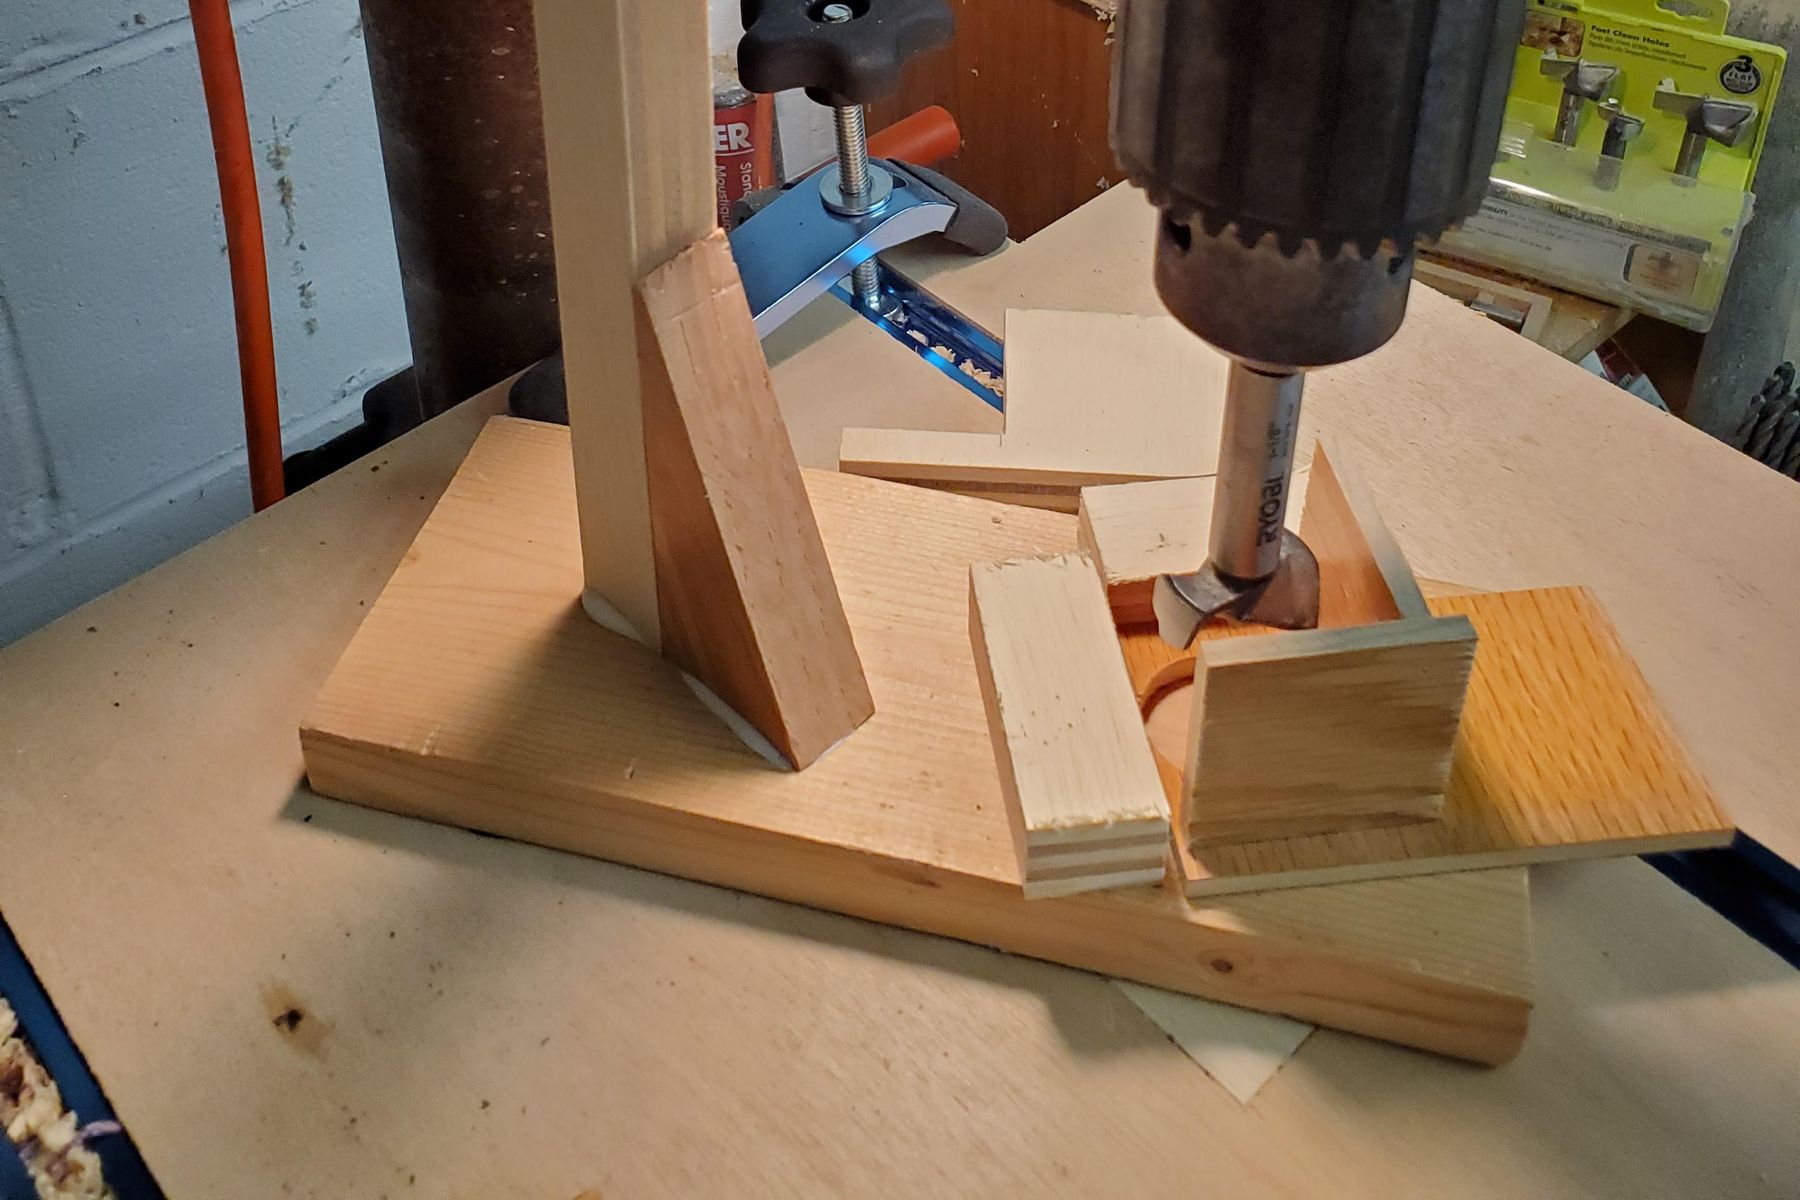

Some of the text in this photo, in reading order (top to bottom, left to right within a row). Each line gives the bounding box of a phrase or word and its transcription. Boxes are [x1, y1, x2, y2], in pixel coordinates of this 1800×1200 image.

[1591, 25, 1610, 35] Fast
[1613, 30, 1640, 41] Clean
[1642, 36, 1670, 48] Holes
[1734, 54, 1753, 73] 3
[715, 122, 752, 151] ER
[1256, 471, 1284, 548] RYOBI
